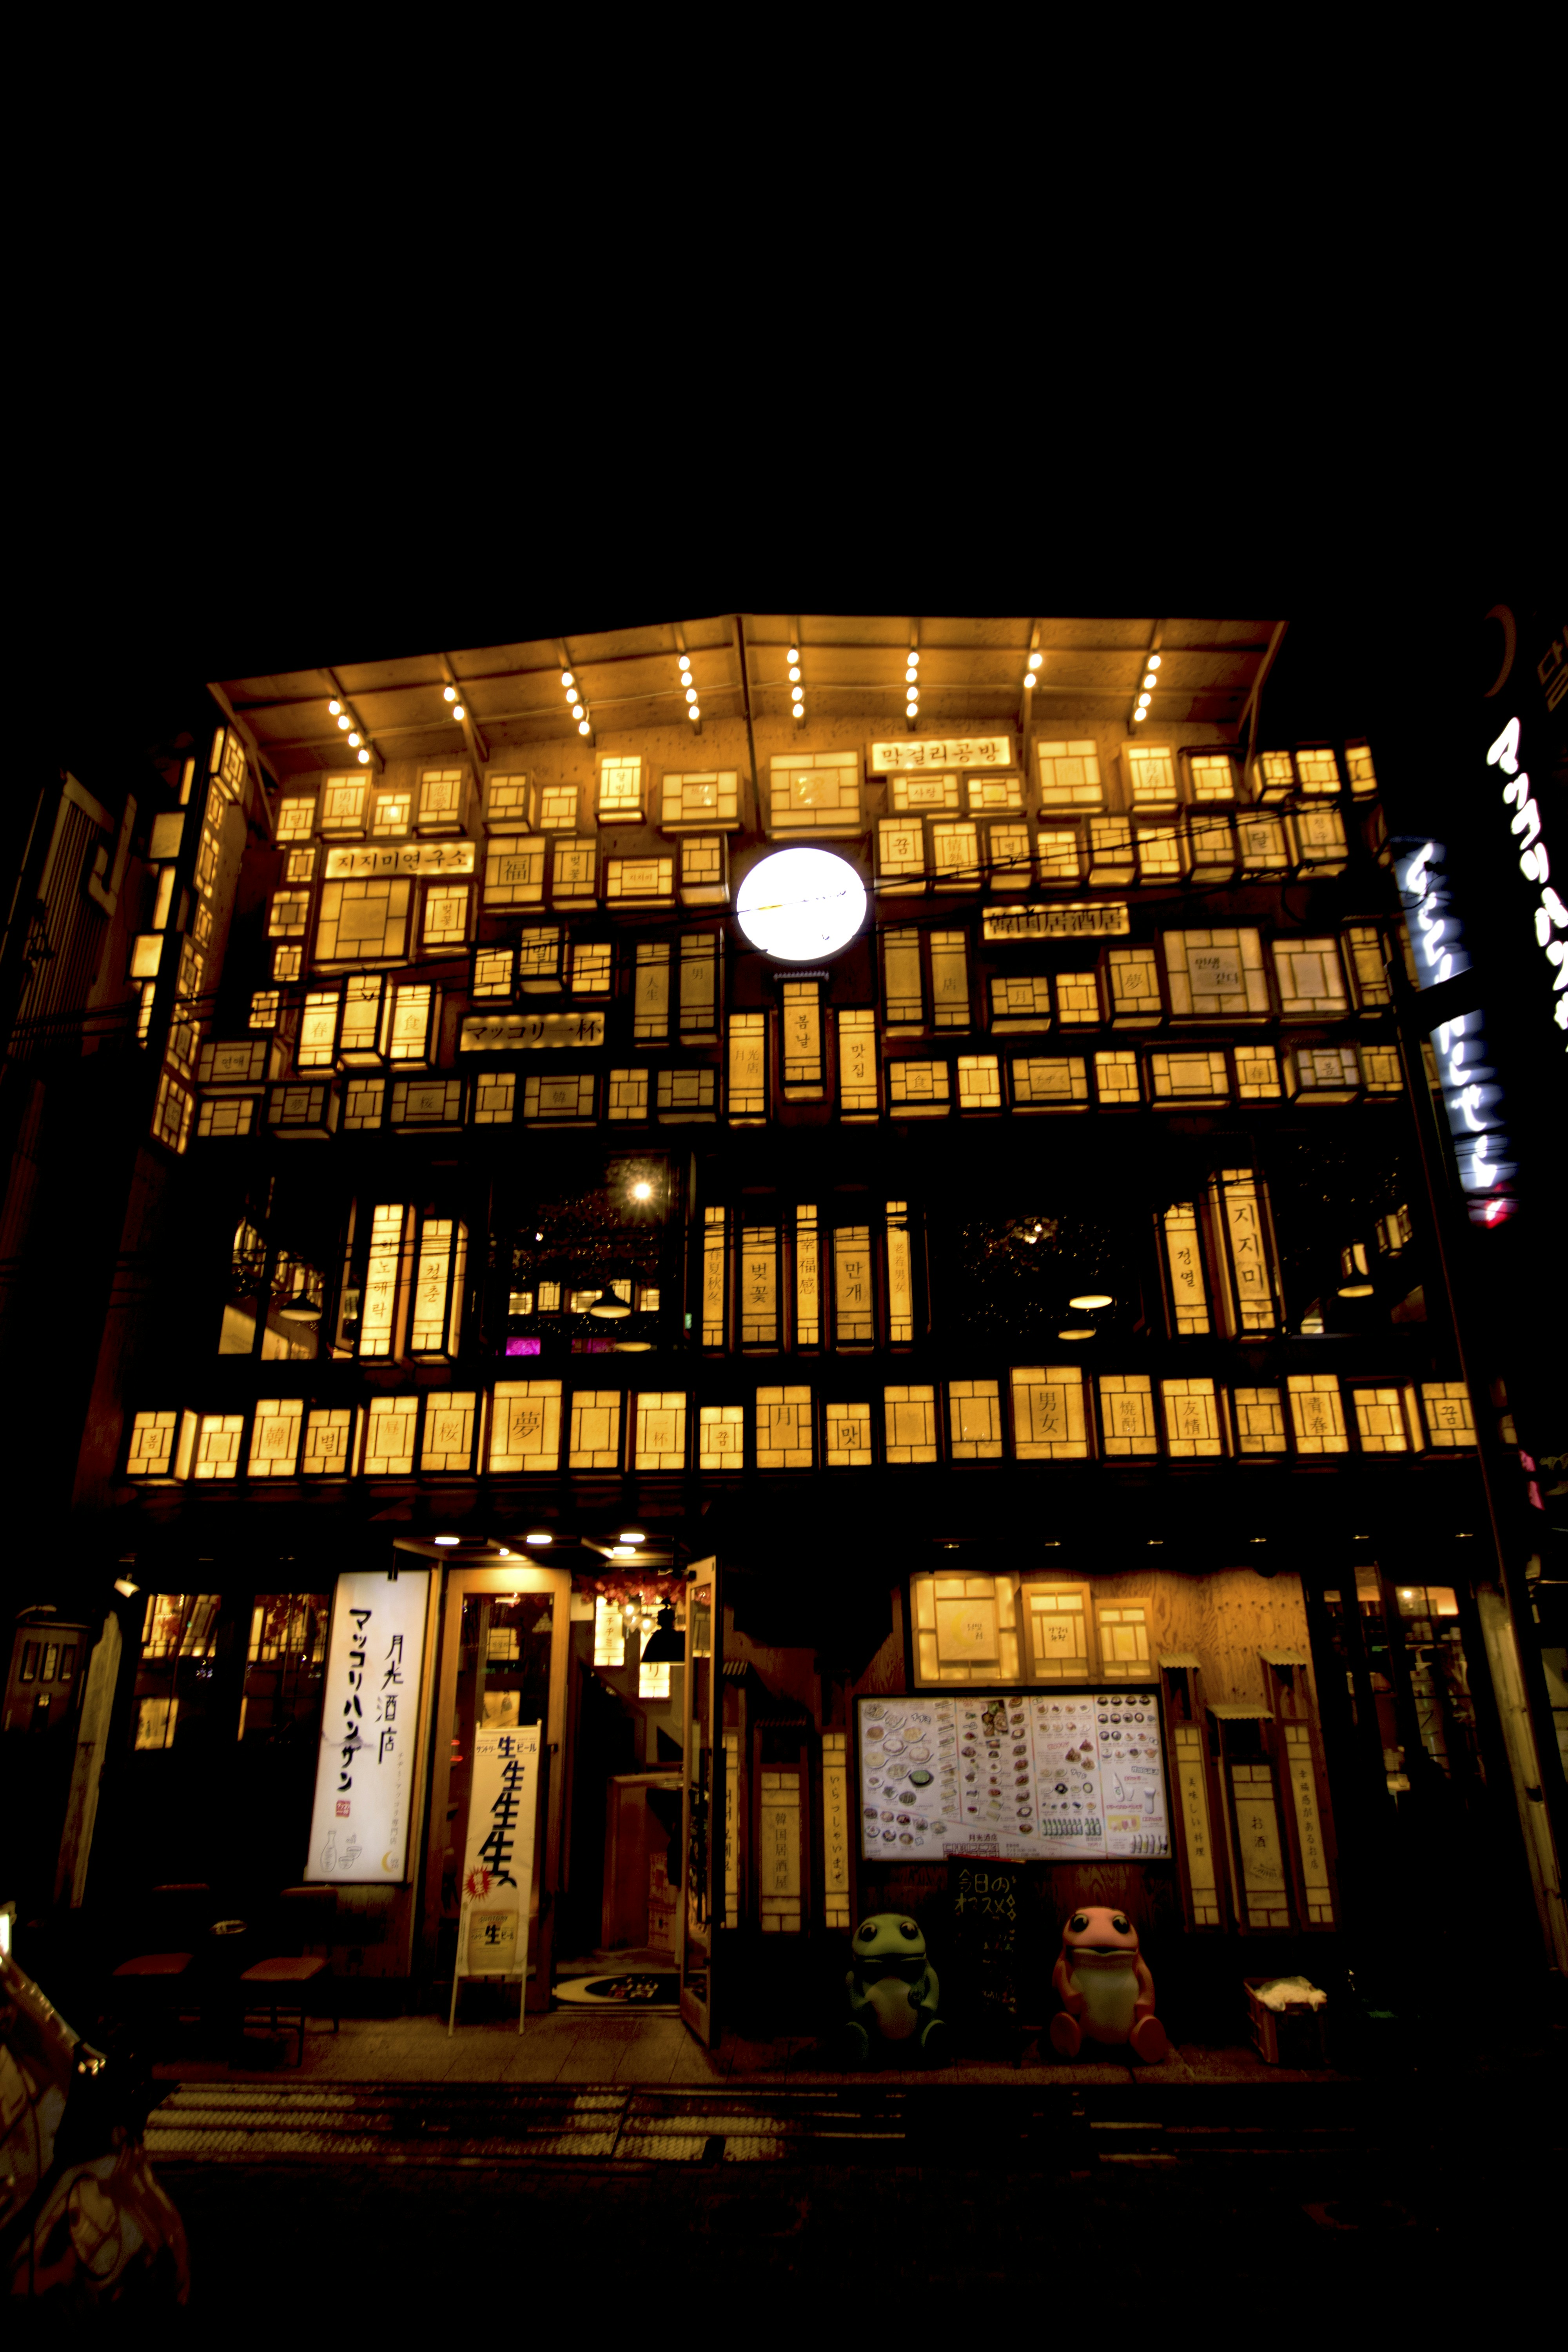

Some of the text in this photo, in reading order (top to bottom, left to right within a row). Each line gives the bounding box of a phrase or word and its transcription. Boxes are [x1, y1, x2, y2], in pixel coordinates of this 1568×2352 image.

[882, 742, 999, 765] 막걸리공방
[616, 772, 626, 795] 달빛
[912, 787, 936, 799] 사랑
[290, 813, 302, 826] 달
[891, 838, 909, 855] 꿈
[336, 849, 468, 871] 지지미연구소
[503, 859, 527, 881] 福
[570, 855, 581, 880] 벚꽃
[629, 873, 653, 882] 지지미
[442, 903, 452, 926] 벚꽃
[692, 968, 703, 980] 男
[1195, 957, 1220, 970] 인생
[646, 976, 659, 1002] 人生
[942, 978, 956, 991] 店
[1125, 973, 1143, 990] 夢
[1014, 990, 1026, 1003] 月
[311, 1022, 328, 1038] 春
[403, 1014, 420, 1031] 食
[467, 1018, 602, 1044] マッコリ一杯
[794, 1014, 811, 1048] 봄날
[221, 1057, 244, 1069] 연애
[851, 1044, 866, 1078] 맛집
[912, 1075, 926, 1088] 食
[1233, 1203, 1264, 1291] 지지미
[707, 1247, 722, 1306] 春夏秋冬
[799, 1236, 817, 1294] 幸福感
[893, 1242, 906, 1293] 老若男女
[423, 1263, 440, 1303] 청춘
[749, 1261, 769, 1304] 벚꽃
[845, 1261, 864, 1301] 만개
[775, 1407, 791, 1426] 月
[1038, 1392, 1059, 1434] 男女
[1182, 1400, 1200, 1436] 友情
[1307, 1396, 1327, 1434] 青春
[1441, 1405, 1458, 1425] 꿈
[265, 1426, 286, 1448] 韓
[438, 1421, 459, 1443] 桜
[512, 1411, 541, 1441] 夢
[653, 1422, 668, 1447] 一杯
[841, 1425, 858, 1446] 맛
[145, 1434, 158, 1449] 봄
[715, 1431, 729, 1446] 꿈
[605, 1617, 615, 1648] チヂミ
[374, 1634, 404, 1764] 月光酒店
[1188, 1777, 1205, 1857] 美味しい料理
[830, 1774, 843, 1884] いらっしゃいませ
[1251, 1815, 1266, 1848] お酒
[775, 1811, 787, 1889] 韓国居酒屋
[958, 1868, 1010, 1893] 今日の
